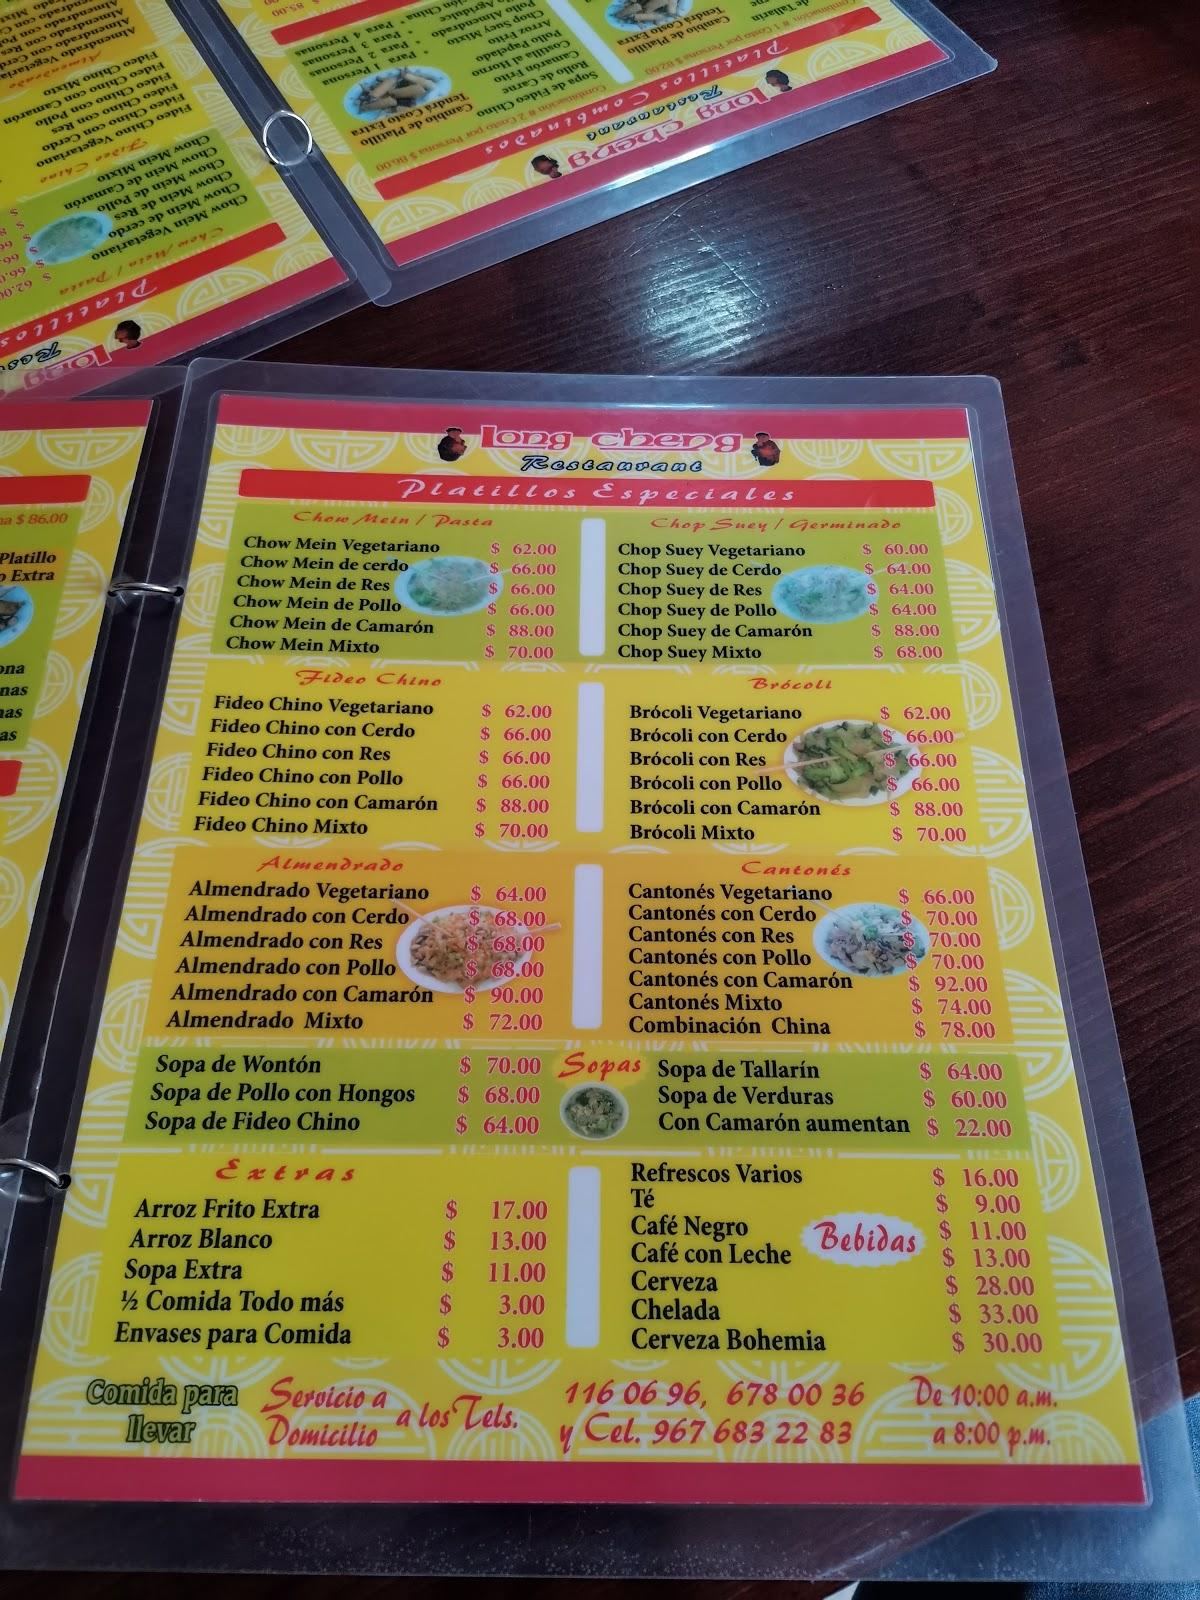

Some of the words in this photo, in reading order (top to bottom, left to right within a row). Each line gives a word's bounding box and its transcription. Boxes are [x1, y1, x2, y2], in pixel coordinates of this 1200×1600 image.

[512, 9, 544, 23] Chop
[483, 20, 512, 33] Suey
[446, 29, 483, 45] Mixto
[493, 68, 524, 83] Frito
[539, 71, 554, 81] de
[555, 59, 589, 75] Rollo
[501, 77, 539, 94] Carne
[550, 81, 566, 91] de
[566, 70, 598, 85] Sopa
[515, 87, 551, 103] Fideo
[155, 103, 192, 121] Fideo
[424, 103, 473, 123] Cambio
[475, 100, 515, 117] Chino
[585, 84, 723, 141] Restaurant
[114, 118, 154, 137] Chino
[408, 119, 423, 129] de
[173, 134, 210, 153] Chow
[359, 125, 407, 146] Platillo
[35, 135, 113, 168] Vegetariano
[136, 148, 171, 166] Mein
[96, 162, 136, 182] Mixto
[210, 194, 248, 214] Chow
[172, 209, 209, 228] Mein
[90, 225, 173, 260] Vegetariano
[521, 455, 704, 473] Restaurant
[398, 478, 576, 500] Platillos
[592, 482, 796, 505] Especiales
[27, 512, 69, 525] 86.00
[244, 536, 292, 549] Chow
[296, 537, 336, 550] Mein
[342, 539, 440, 555] Vegetariano
[512, 544, 557, 555] 62.00
[618, 543, 661, 559] Chop
[666, 544, 704, 559] Suey
[708, 544, 805, 560] Vegetariano
[884, 543, 929, 555] 60.00
[0, 551, 57, 564] Platillo
[240, 555, 288, 568] Chow
[292, 557, 334, 569] Mein
[339, 558, 359, 570] de
[363, 559, 408, 572] cerdo
[512, 564, 556, 575] 66.00
[11, 569, 55, 582] Extra
[618, 623, 662, 640] Chop
[667, 624, 706, 641] Suey
[711, 624, 730, 637] de
[735, 624, 813, 637] Camarón
[895, 624, 940, 636] 88.00
[226, 636, 276, 650] Chow
[280, 638, 323, 651] Mein
[328, 639, 379, 653] Mixto
[509, 646, 554, 659] 70.00
[296, 670, 366, 685] Fideo
[376, 673, 441, 686] Chino
[630, 705, 692, 719] Brócoli
[697, 706, 802, 723] Vegetariano
[904, 707, 951, 720] 62.00
[206, 742, 257, 757] Fideo
[262, 744, 317, 759] Chino
[322, 749, 353, 760] con
[359, 746, 390, 761] Res
[503, 751, 551, 765] 66.00
[630, 775, 694, 790] Brócoli
[699, 780, 731, 790] con
[737, 776, 782, 790] Pollo
[912, 778, 960, 791] 66.00
[257, 856, 403, 872] Almendrado
[742, 861, 850, 876] Cantonés
[629, 904, 716, 920] Cantonés
[721, 910, 754, 921] con
[759, 906, 816, 922] Cerdo
[927, 911, 977, 925] 70.00
[170, 983, 297, 1001] Almendrado
[303, 989, 337, 1002] con
[343, 985, 433, 1003] Camarón
[491, 987, 543, 1004] 90.00
[629, 1016, 761, 1034] Combinación
[771, 1017, 831, 1035] China
[941, 1022, 995, 1038] 78.00
[156, 1054, 206, 1078] Sopa
[211, 1054, 236, 1072] de
[243, 1055, 321, 1073] Wontón
[488, 1057, 541, 1074] 70.00
[558, 1052, 641, 1081] Sopas
[658, 1085, 708, 1109] Sopa
[713, 1085, 737, 1104] de
[741, 1086, 834, 1105] Verduras
[951, 1091, 1007, 1108] 60.00
[659, 1112, 700, 1131] Con
[706, 1112, 800, 1132] Camarón
[806, 1116, 910, 1133] aumentan
[955, 1119, 1011, 1137] 22.00
[216, 1158, 354, 1181] Extras
[631, 1162, 730, 1183] Refrescos
[735, 1164, 802, 1184] Varios
[963, 1168, 1018, 1187] 16.00
[133, 1198, 197, 1218] Arroz
[202, 1199, 255, 1218] Frito
[261, 1199, 320, 1219] Extra
[493, 1201, 547, 1220] 17.00
[814, 1221, 915, 1253] Bebidas
[631, 1241, 679, 1263] Café
[684, 1249, 723, 1263] con
[729, 1242, 791, 1264] Leche
[974, 1248, 1030, 1268] 13.00
[114, 1321, 201, 1343] Envases
[205, 1328, 257, 1350] para
[264, 1322, 351, 1344] Comida
[498, 1327, 544, 1348] 3.00
[631, 1327, 720, 1350] Cerveza
[726, 1328, 826, 1351] Bohemia
[983, 1332, 1042, 1353] 30.00
[86, 1376, 177, 1406] Comida
[181, 1384, 239, 1415] para
[260, 1376, 365, 1413] Servicio
[372, 1391, 387, 1408] a
[565, 1379, 614, 1404] 116
[624, 1379, 658, 1405] 06
[666, 1380, 706, 1409] 96,
[726, 1381, 778, 1406] 678
[788, 1383, 822, 1406] 00
[832, 1382, 864, 1406] 36
[910, 1375, 942, 1407] De
[951, 1384, 1009, 1406] 10:00
[1016, 1390, 1057, 1407] a.m.
[396, 1409, 411, 1427] a
[419, 1400, 449, 1430] los
[451, 1394, 518, 1431] Tels.
[125, 1414, 197, 1443] llevar
[266, 1414, 378, 1447] Domicilio
[560, 1425, 573, 1454] y
[585, 1412, 640, 1444] Cel.
[652, 1418, 706, 1445] 967
[713, 1418, 764, 1444] 683
[775, 1422, 808, 1444] 22
[820, 1421, 852, 1444] 83
[933, 1427, 945, 1444] a
[954, 1421, 1000, 1444] 8:00
[1008, 1427, 1050, 1456] p.m.
